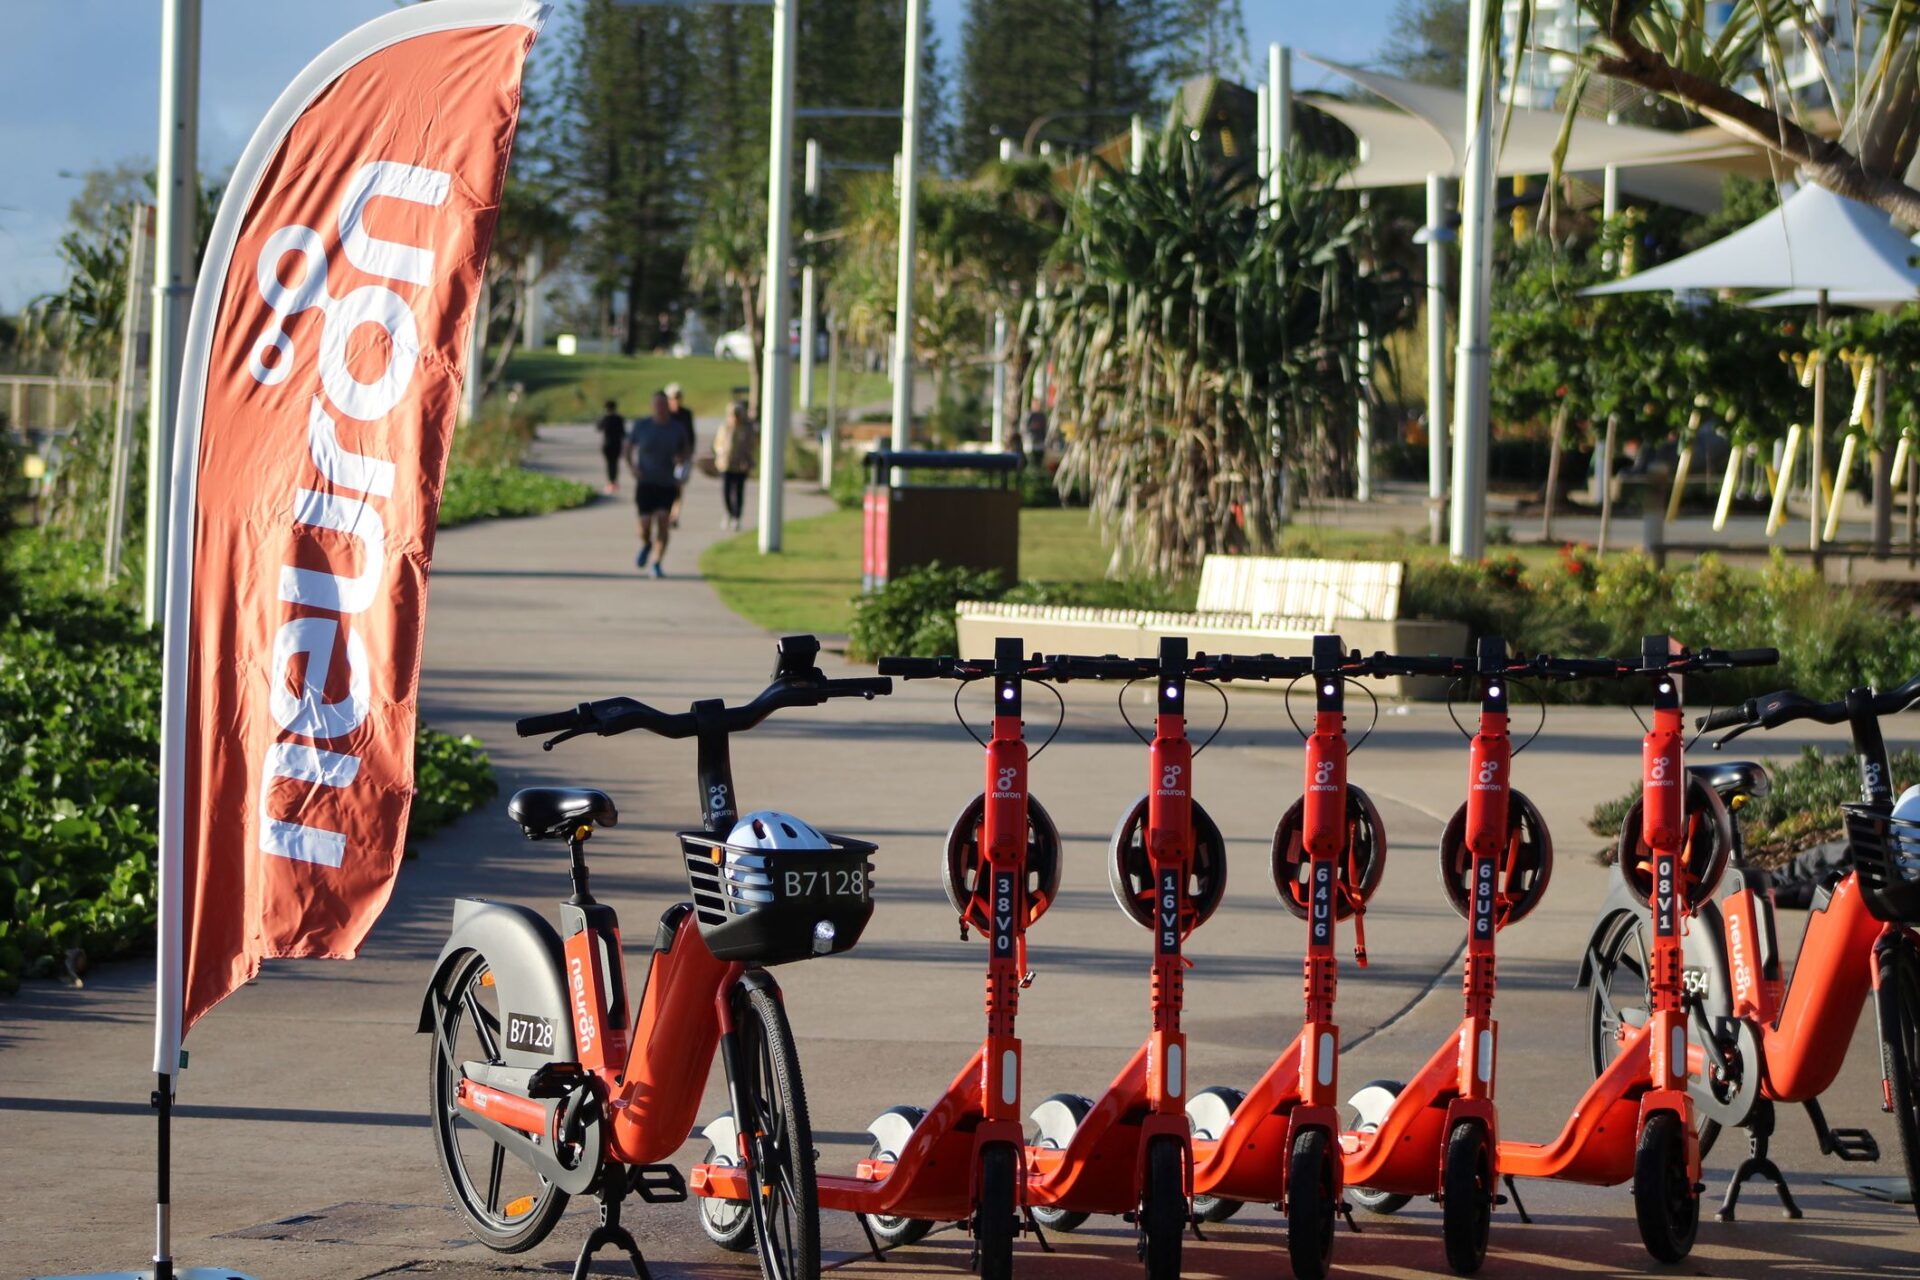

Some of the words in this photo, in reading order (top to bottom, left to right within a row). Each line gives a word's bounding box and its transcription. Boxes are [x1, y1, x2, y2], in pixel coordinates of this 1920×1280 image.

[258, 160, 451, 868] neuron
[784, 870, 864, 897] B7128
[1161, 876, 1177, 946] 16V5
[1314, 868, 1328, 937] 64U6
[1476, 864, 1491, 932] 68U6
[1729, 914, 1750, 1000] neuron
[510, 1018, 553, 1048] B7128
[570, 957, 595, 1053] neuron
